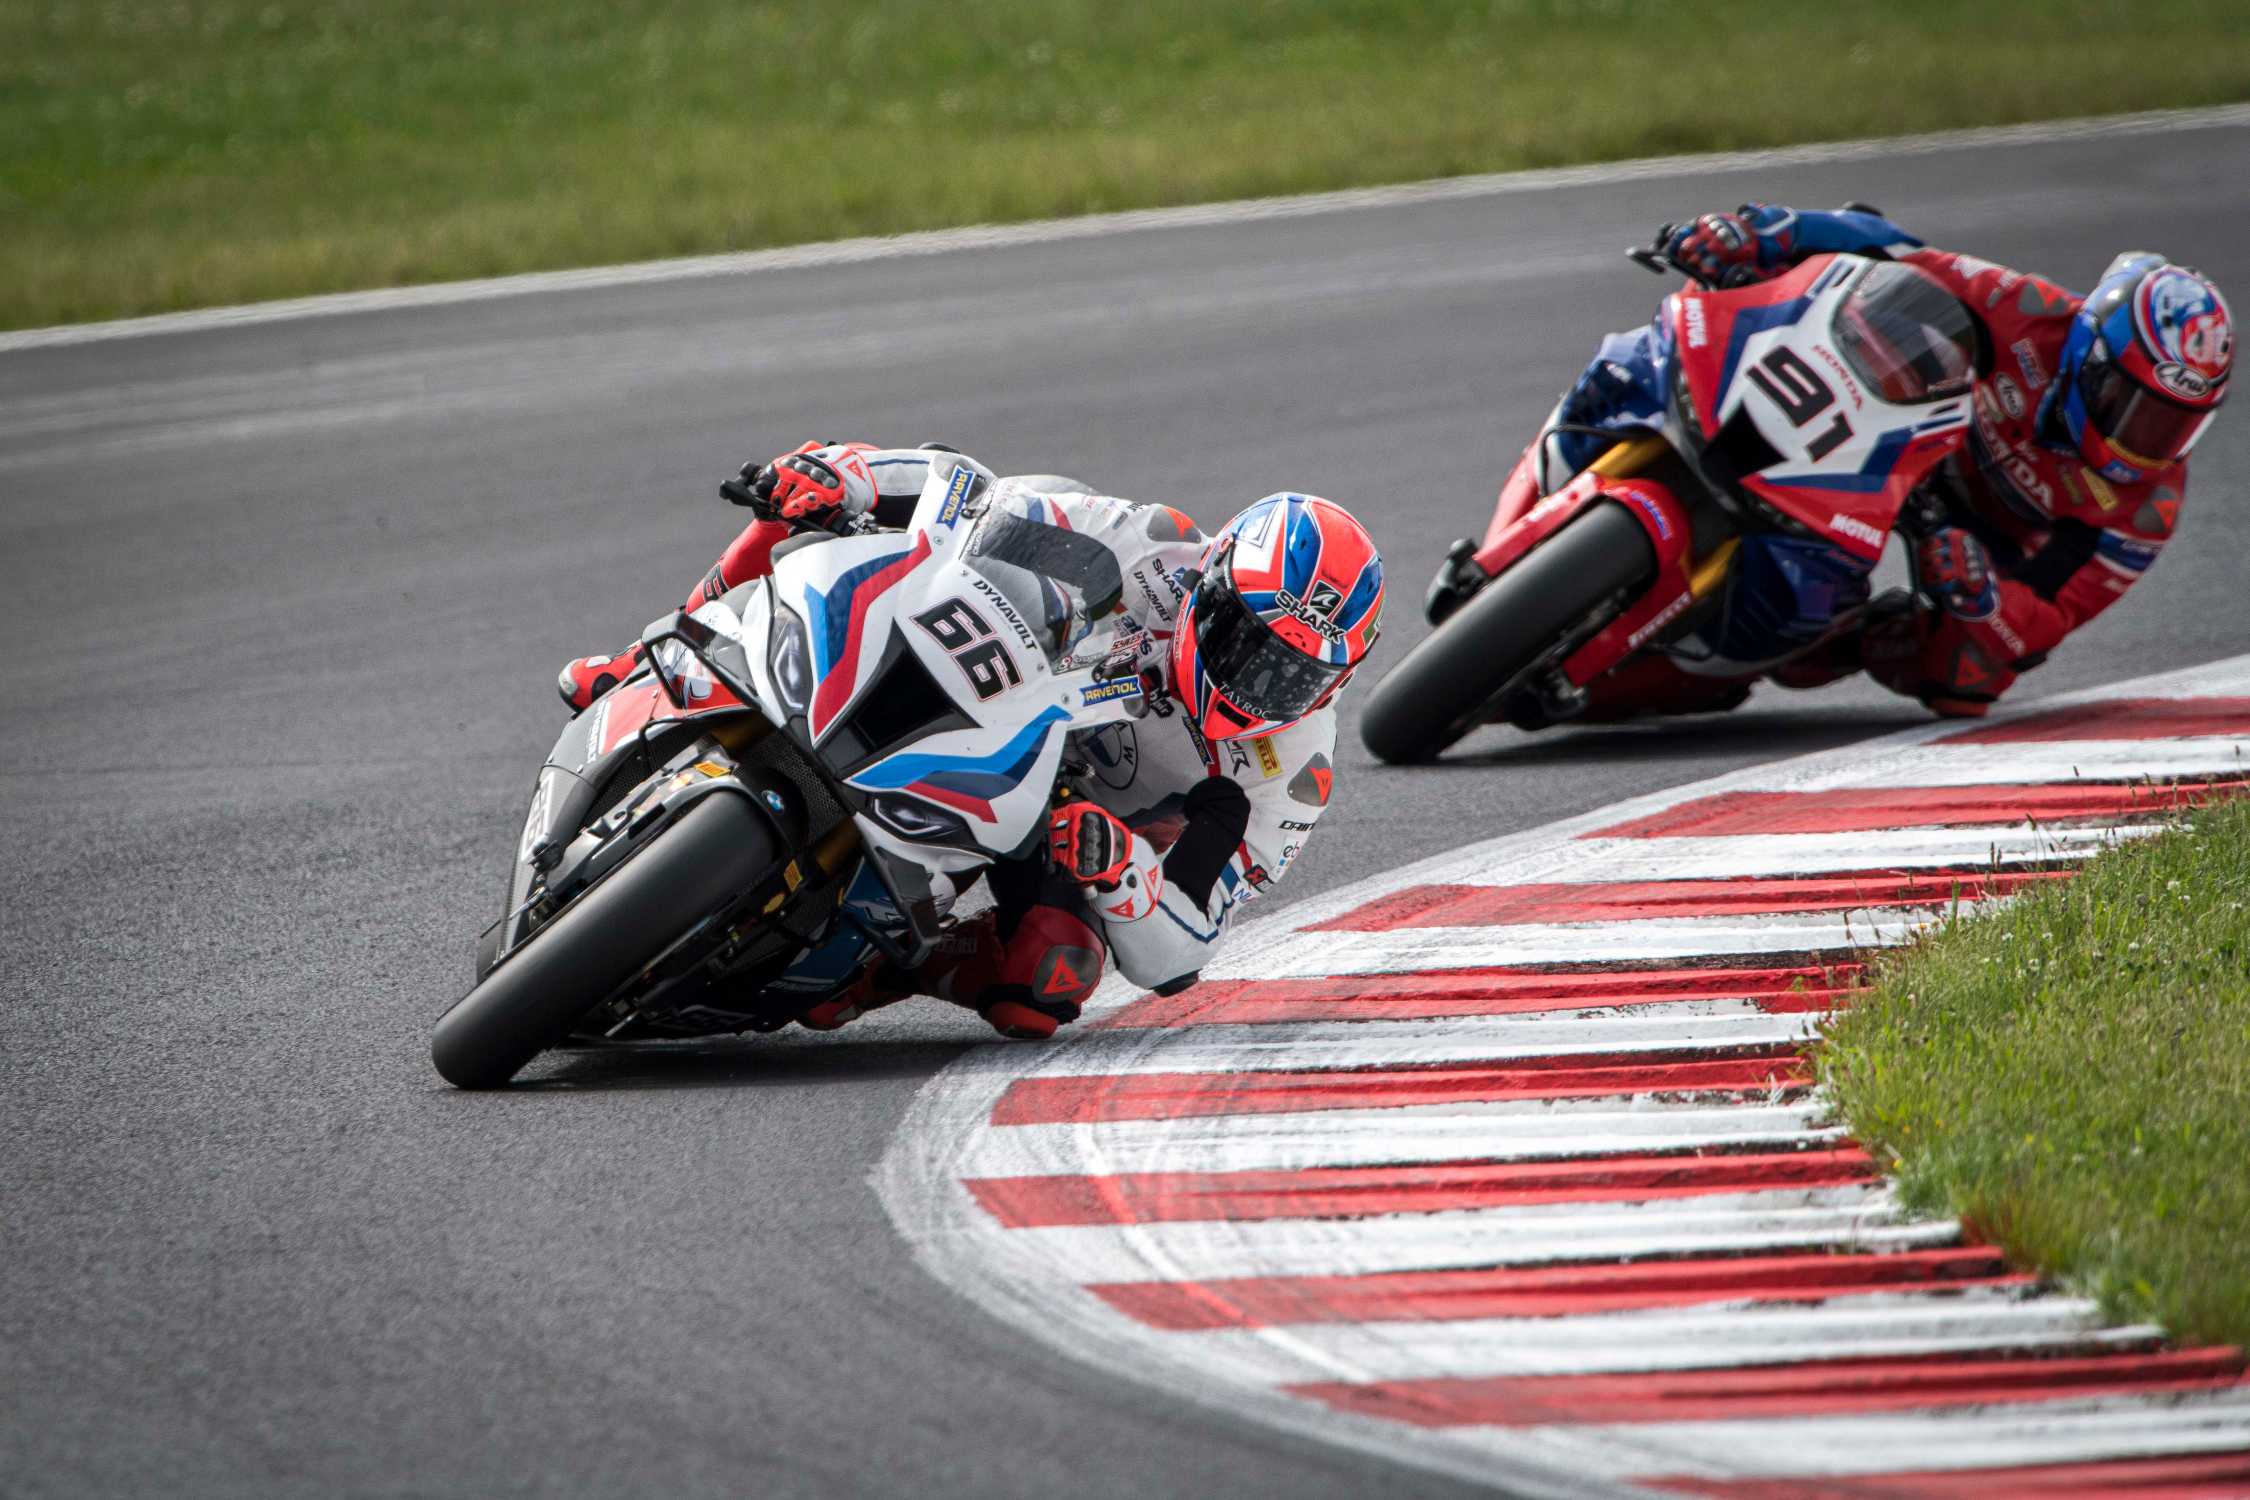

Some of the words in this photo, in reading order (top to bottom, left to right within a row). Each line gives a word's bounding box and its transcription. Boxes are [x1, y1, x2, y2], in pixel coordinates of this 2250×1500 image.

[1684, 297, 1708, 349] MOTUL
[1745, 343, 1855, 464] 91
[1811, 343, 1863, 412] HONDA
[942, 472, 970, 522] RAVENOL
[1829, 513, 1883, 549] MOTUL
[1134, 570, 1172, 622] DYNAVOLT
[1152, 558, 1184, 604] SHAR
[972, 580, 1038, 650] DYNAVOLT
[1274, 588, 1347, 645] SHARK
[909, 595, 1024, 702] 66
[1084, 681, 1137, 702] RAVENOL
[1219, 681, 1272, 720] TAYROC
